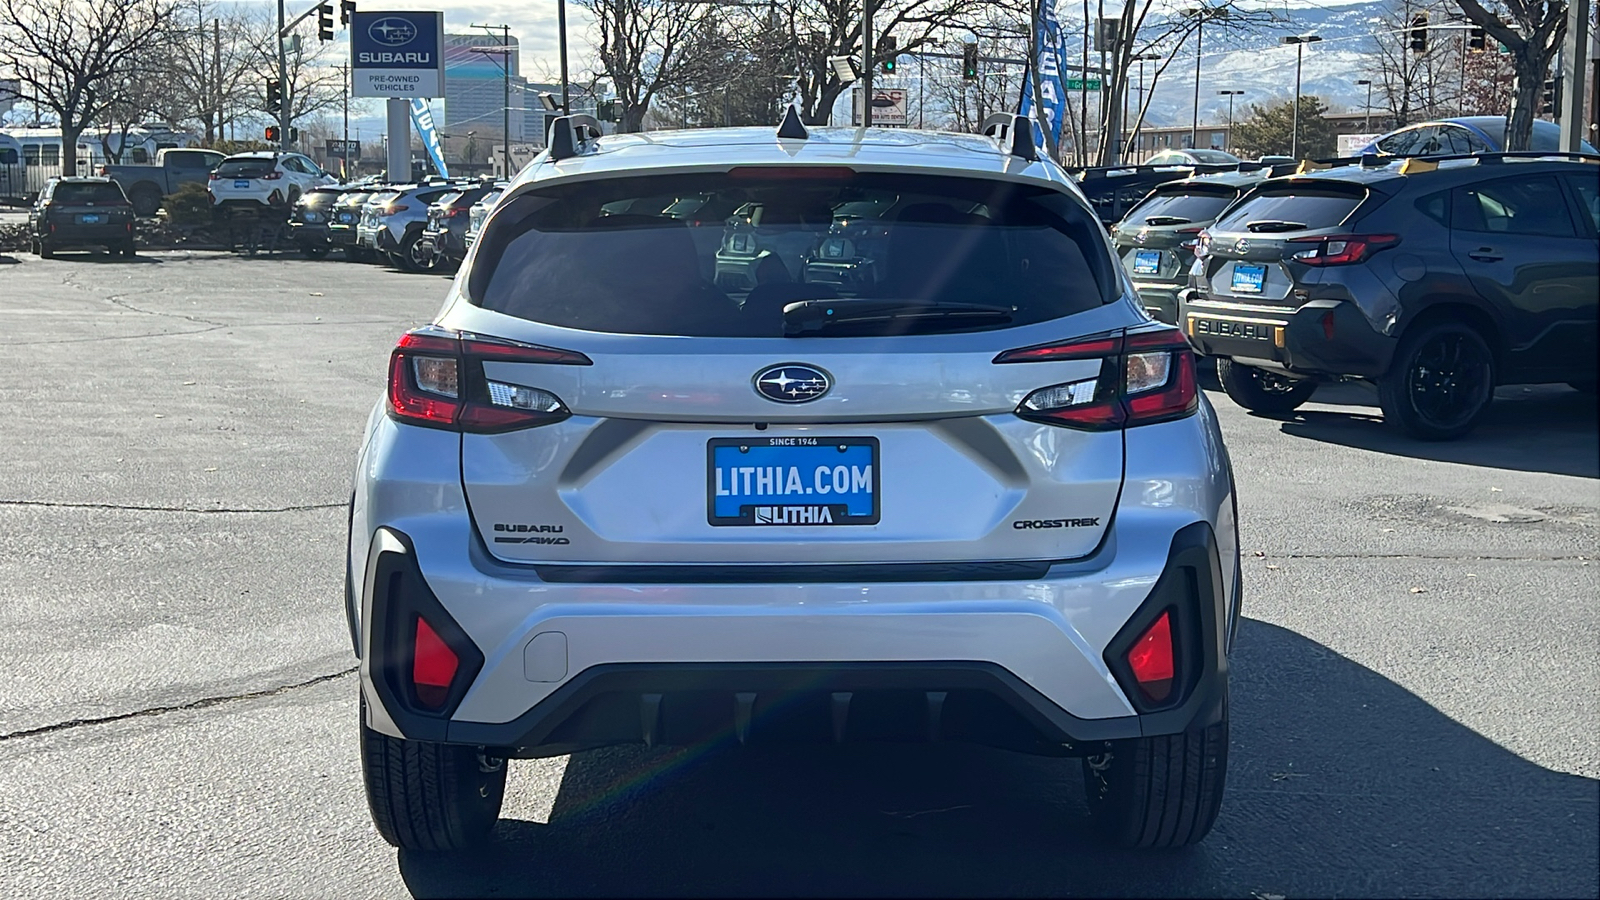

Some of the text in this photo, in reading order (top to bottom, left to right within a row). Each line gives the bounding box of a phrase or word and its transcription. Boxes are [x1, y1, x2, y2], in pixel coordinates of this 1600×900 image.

[359, 52, 430, 63] SUBARU
[369, 75, 420, 83] PRE-OWNED
[374, 84, 415, 92] VEHICLES
[1198, 319, 1269, 340] SUBARU
[769, 438, 818, 446] SINCE 1946
[715, 465, 873, 496] LITHIA.COM
[772, 506, 833, 524] LITHIA
[494, 523, 564, 533] SUBARU
[1013, 517, 1100, 529] CROSSTREK
[508, 537, 571, 545] AWD
